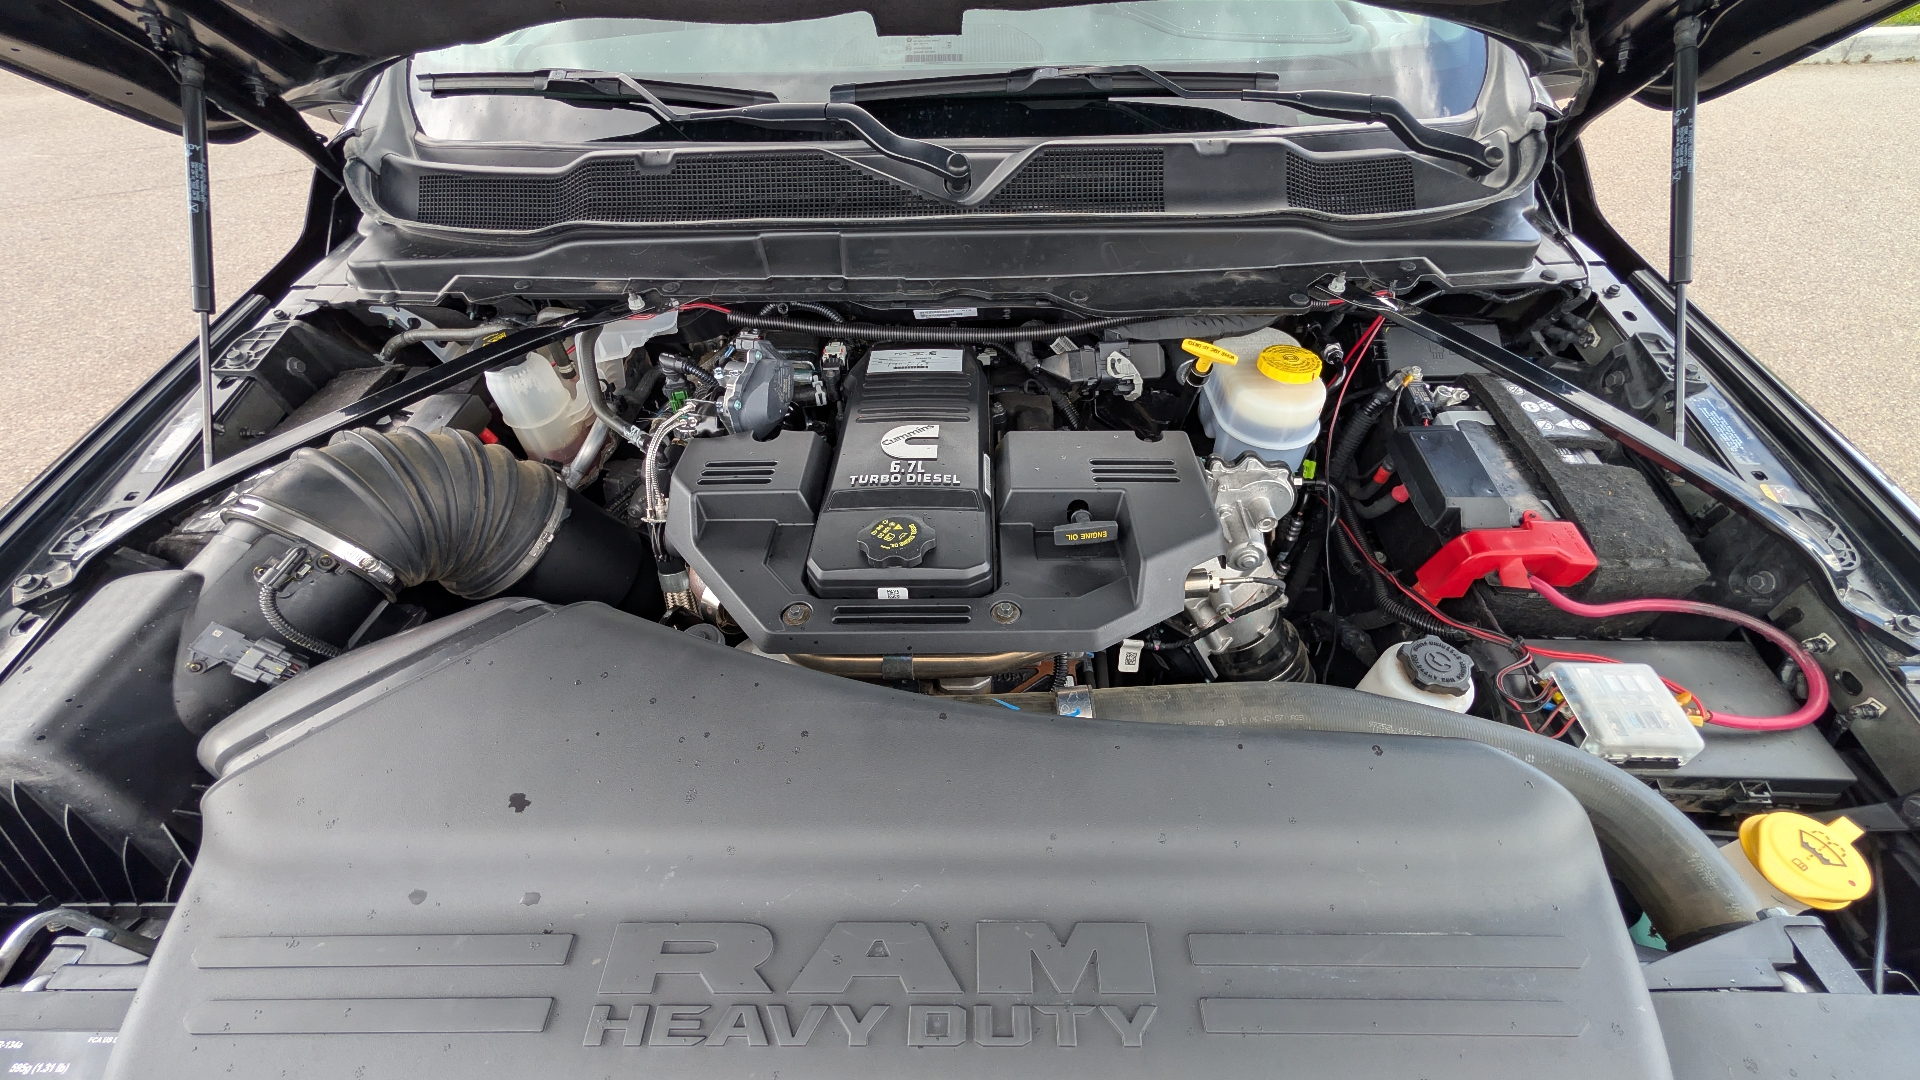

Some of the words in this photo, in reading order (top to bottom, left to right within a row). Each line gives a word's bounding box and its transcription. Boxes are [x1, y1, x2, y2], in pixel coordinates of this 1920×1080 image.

[881, 424, 936, 446] Cummins
[890, 460, 925, 474] 6.7L
[850, 473, 901, 486] TURBO
[906, 473, 961, 485] DIESEL
[1065, 533, 1078, 541] OIL
[1080, 530, 1108, 540] ENGINE
[597, 920, 1157, 995] RAM
[582, 1004, 891, 1047] HEAVY
[907, 1004, 1158, 1047] DUTY
[9, 1062, 33, 1075] 595g
[31, 1062, 56, 1075] (1.31
[55, 1062, 70, 1075] lb)
